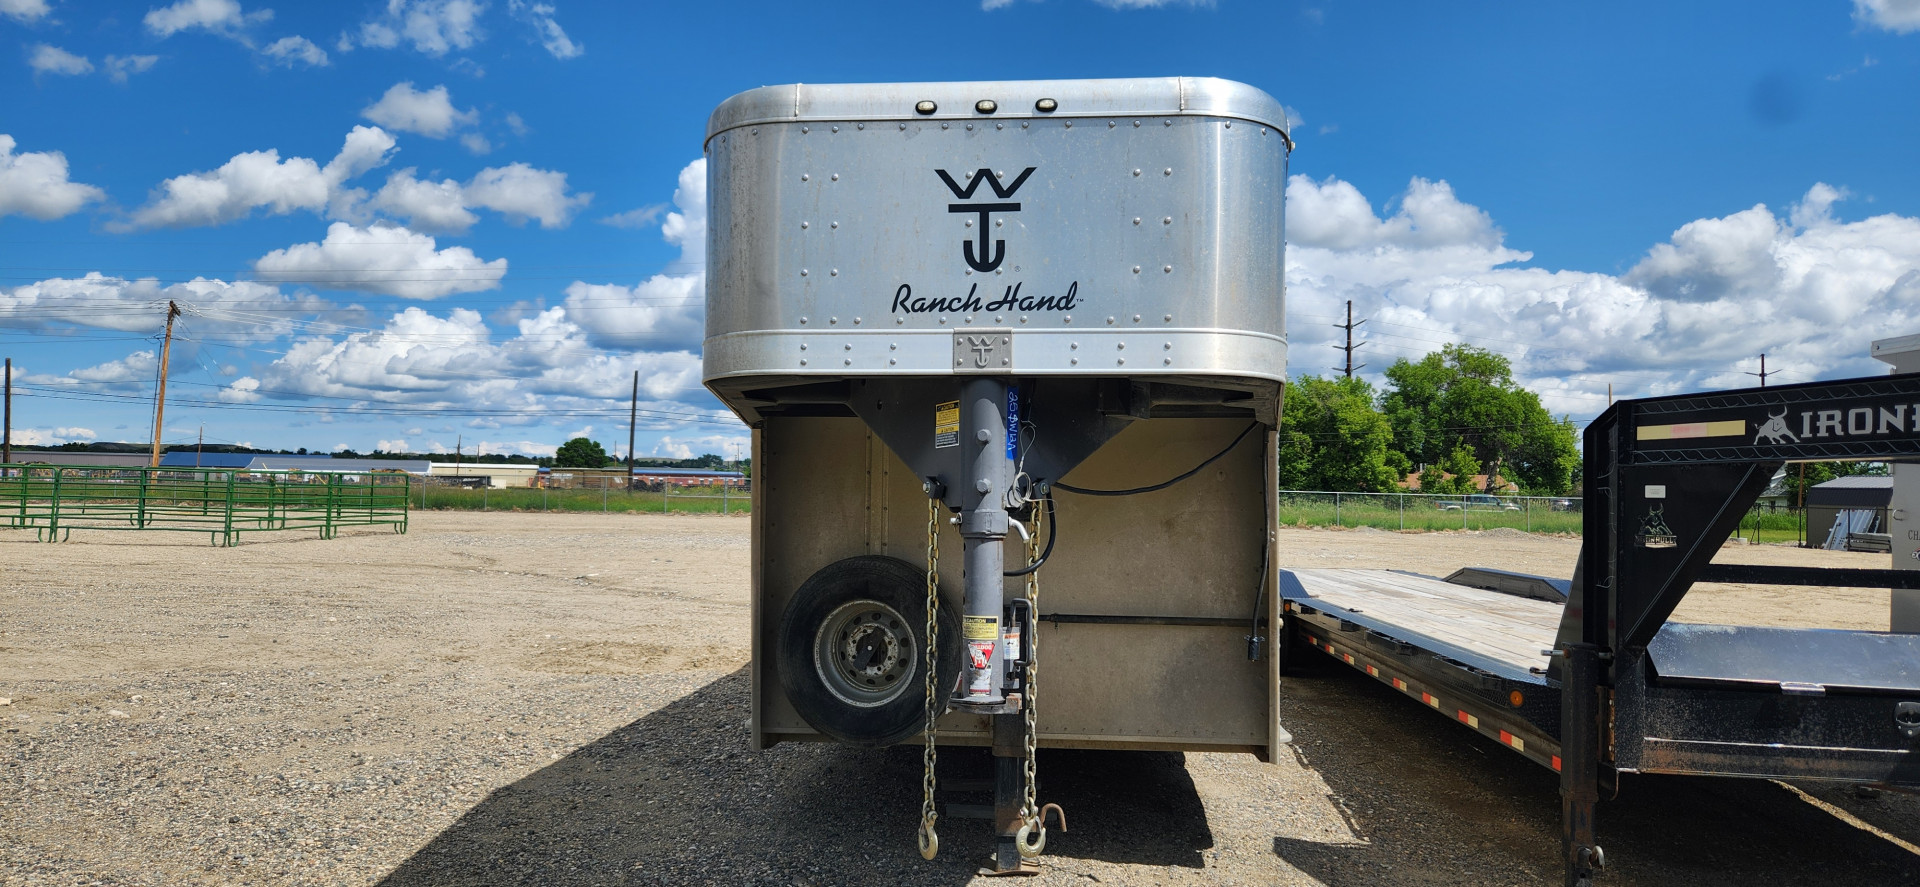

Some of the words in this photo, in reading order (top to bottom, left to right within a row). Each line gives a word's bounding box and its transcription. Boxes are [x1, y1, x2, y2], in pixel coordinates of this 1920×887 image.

[892, 283, 982, 314] Ranch
[985, 280, 1077, 312] Hand
[1908, 529, 1920, 541] CH
